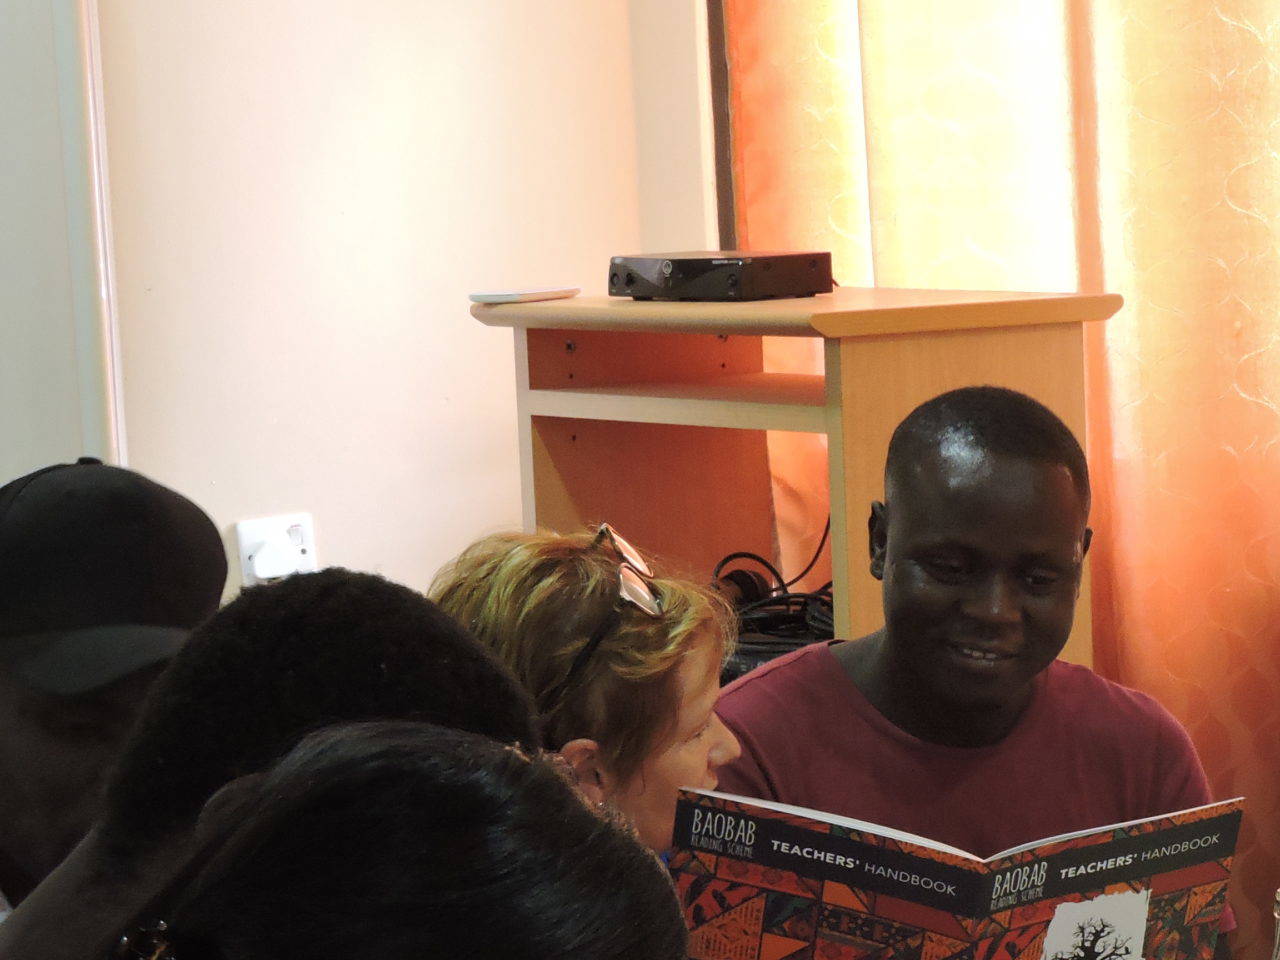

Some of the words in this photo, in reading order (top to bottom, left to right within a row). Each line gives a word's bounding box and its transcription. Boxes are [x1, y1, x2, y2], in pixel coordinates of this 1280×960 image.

[691, 834, 723, 852] READING
[727, 843, 754, 858] SCHEME
[692, 808, 757, 846] BAOBAB
[771, 839, 860, 869] TEACHERS'
[865, 861, 957, 896] HANDBOOK
[1060, 853, 1138, 880] TEACHERS'
[1141, 833, 1221, 862] HANDBOOK
[990, 894, 1018, 910] READING
[1021, 887, 1044, 903] SCHEME
[992, 861, 1048, 900] BAOBAB
